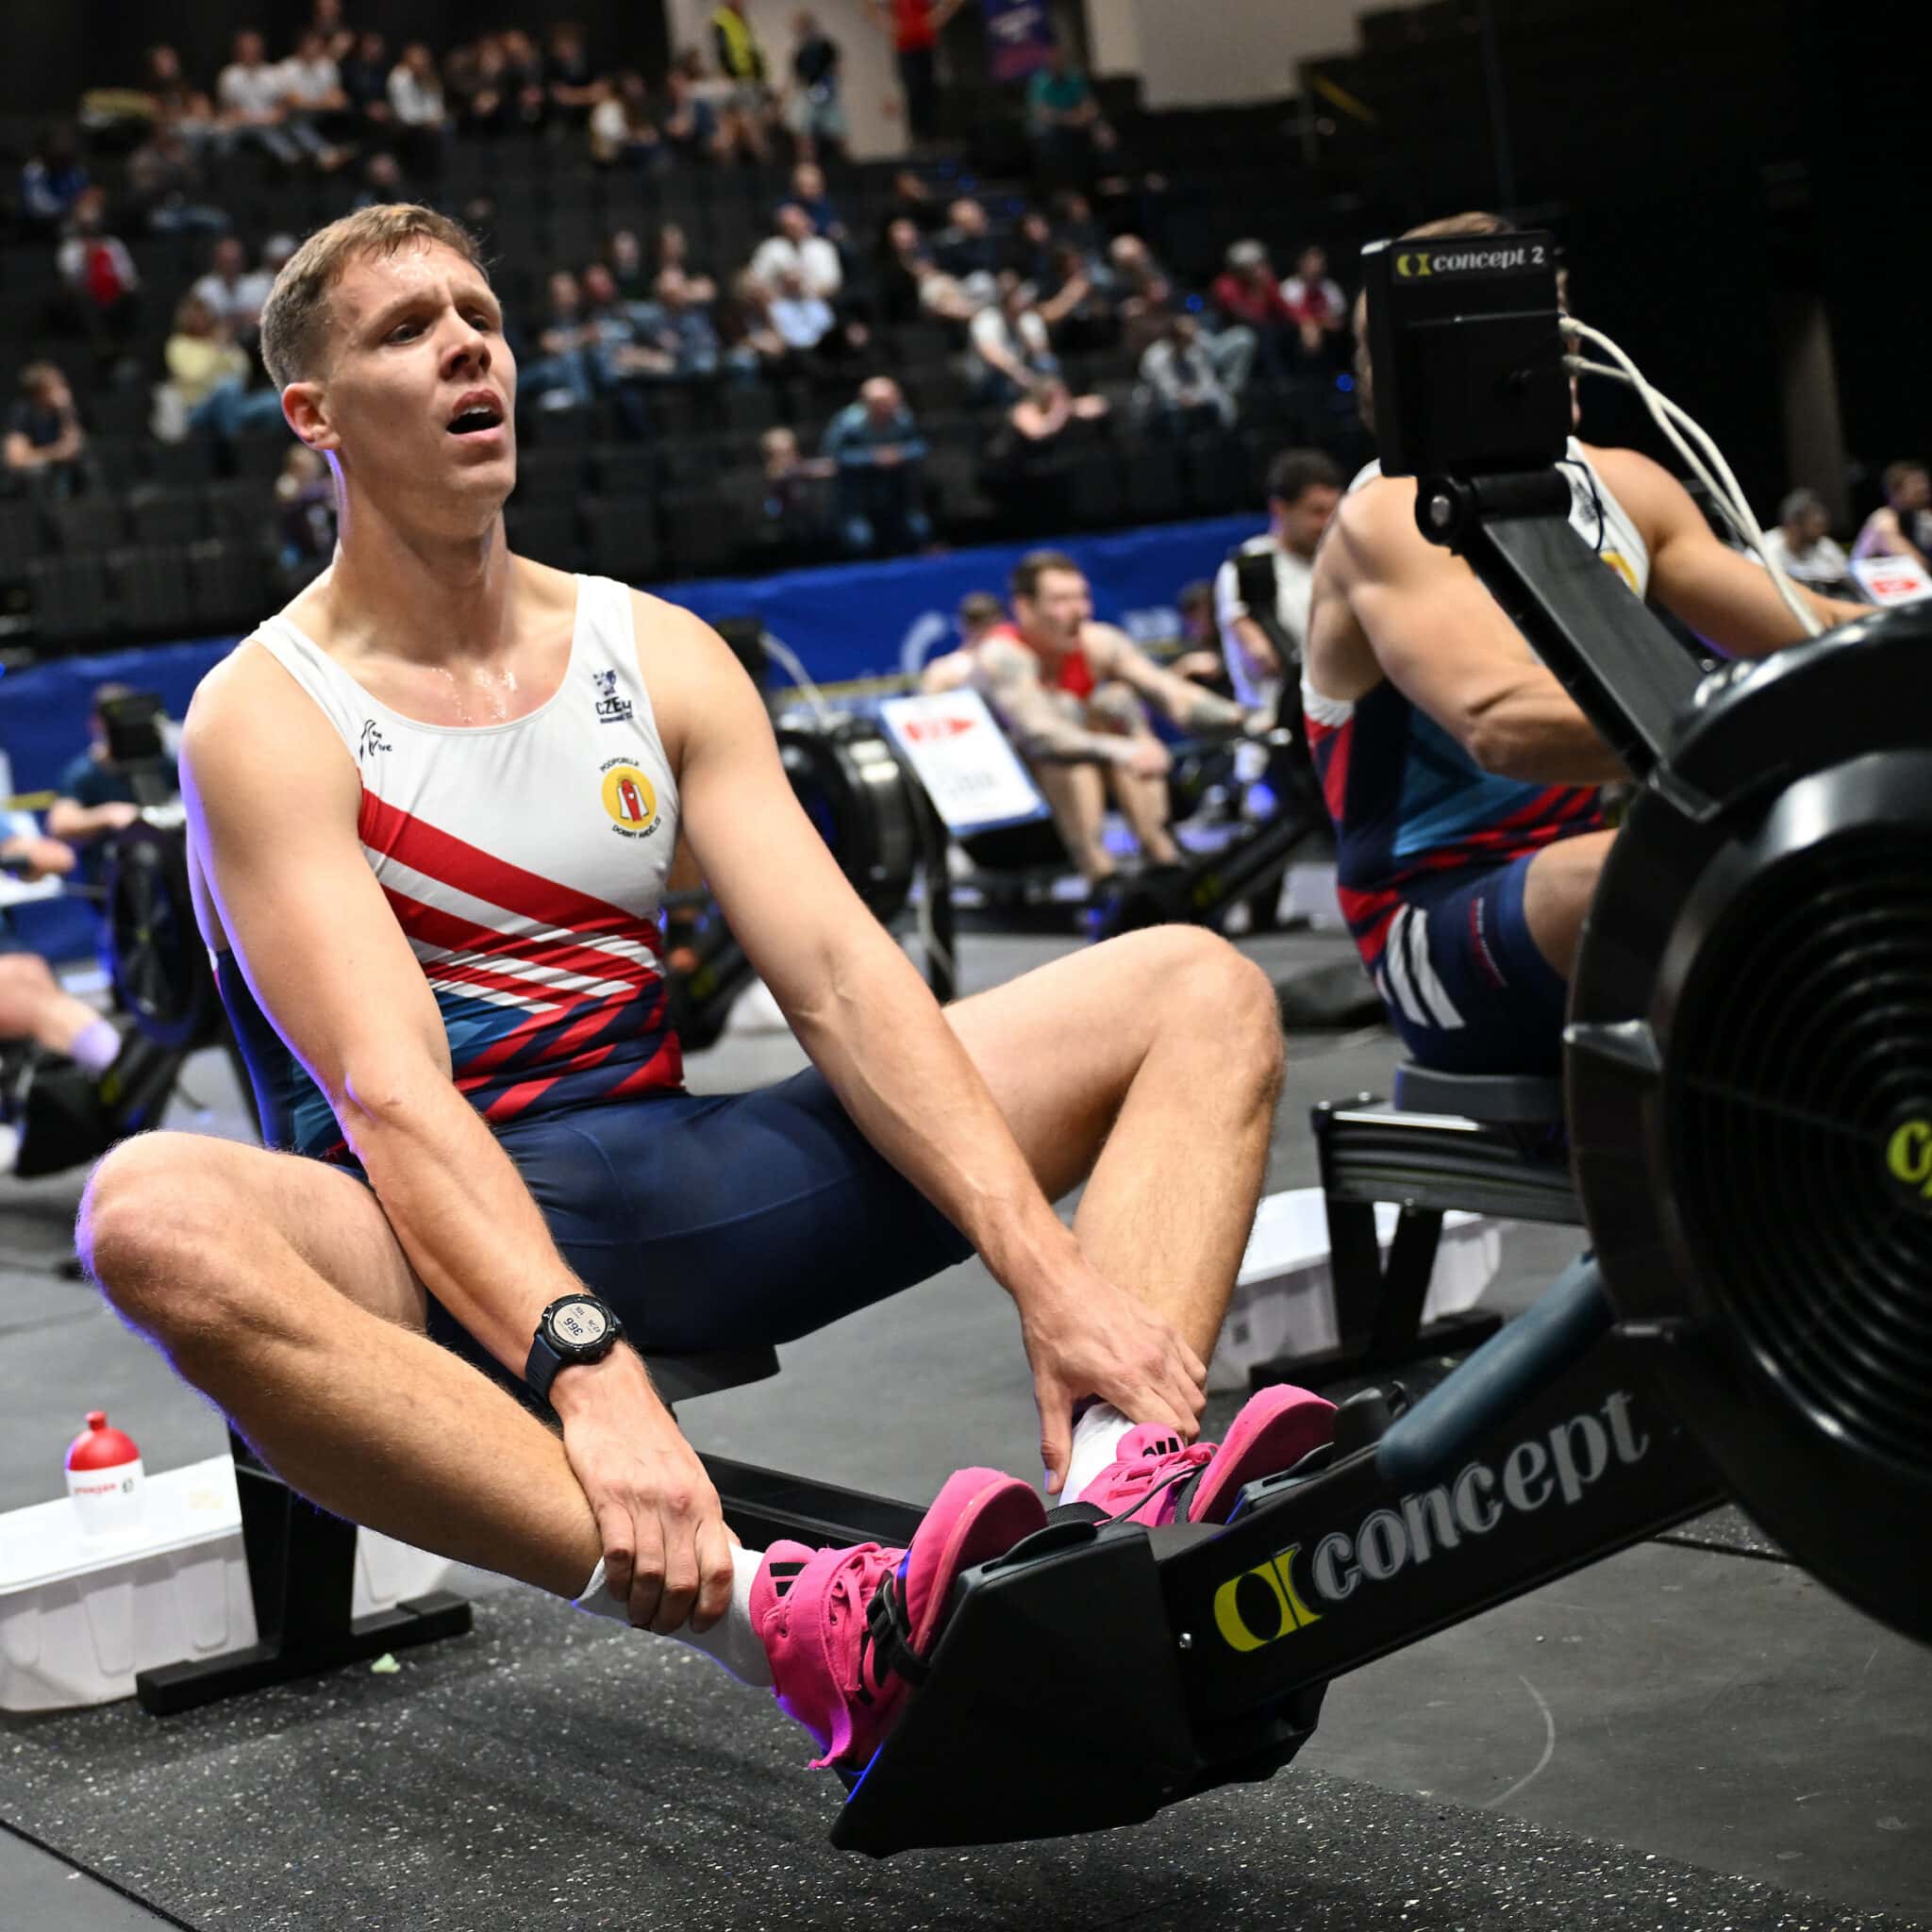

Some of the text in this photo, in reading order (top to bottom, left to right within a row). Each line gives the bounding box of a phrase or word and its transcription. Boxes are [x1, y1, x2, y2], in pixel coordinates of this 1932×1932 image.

[1433, 246, 1544, 272] concept 2
[1312, 1389, 1649, 1601] concept
